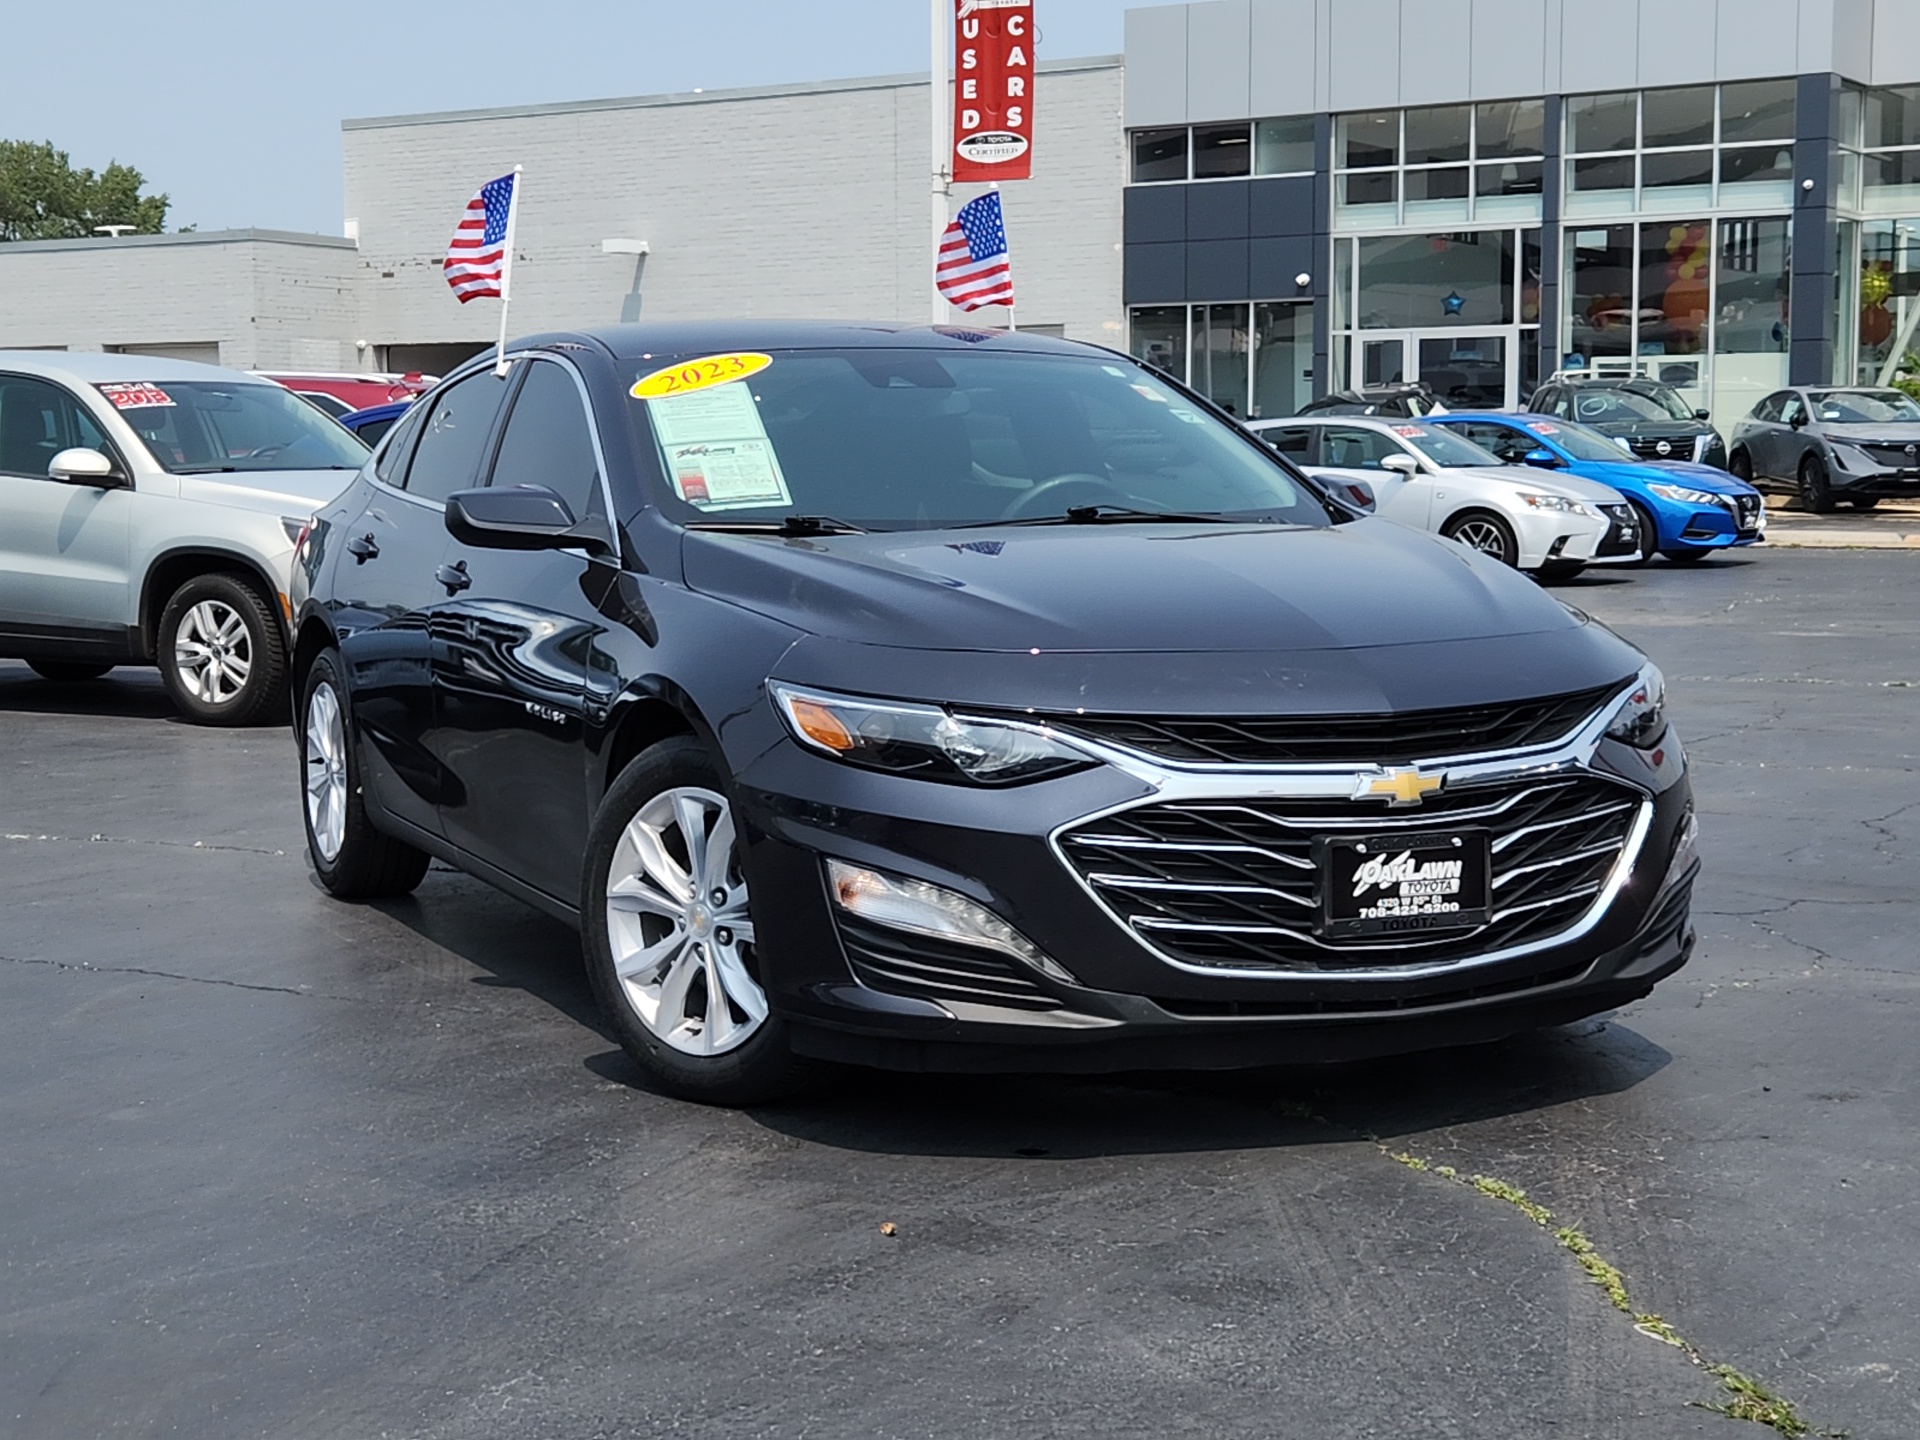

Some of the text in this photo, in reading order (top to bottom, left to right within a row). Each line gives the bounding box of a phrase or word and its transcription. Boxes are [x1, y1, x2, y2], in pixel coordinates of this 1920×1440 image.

[962, 18, 980, 129] USED
[1006, 15, 1026, 127] CARS
[658, 356, 745, 393] 2023
[1407, 881, 1453, 893] TOYOTA
[1359, 902, 1460, 919] 708-423-5200
[1381, 916, 1436, 931] TOYOTA
